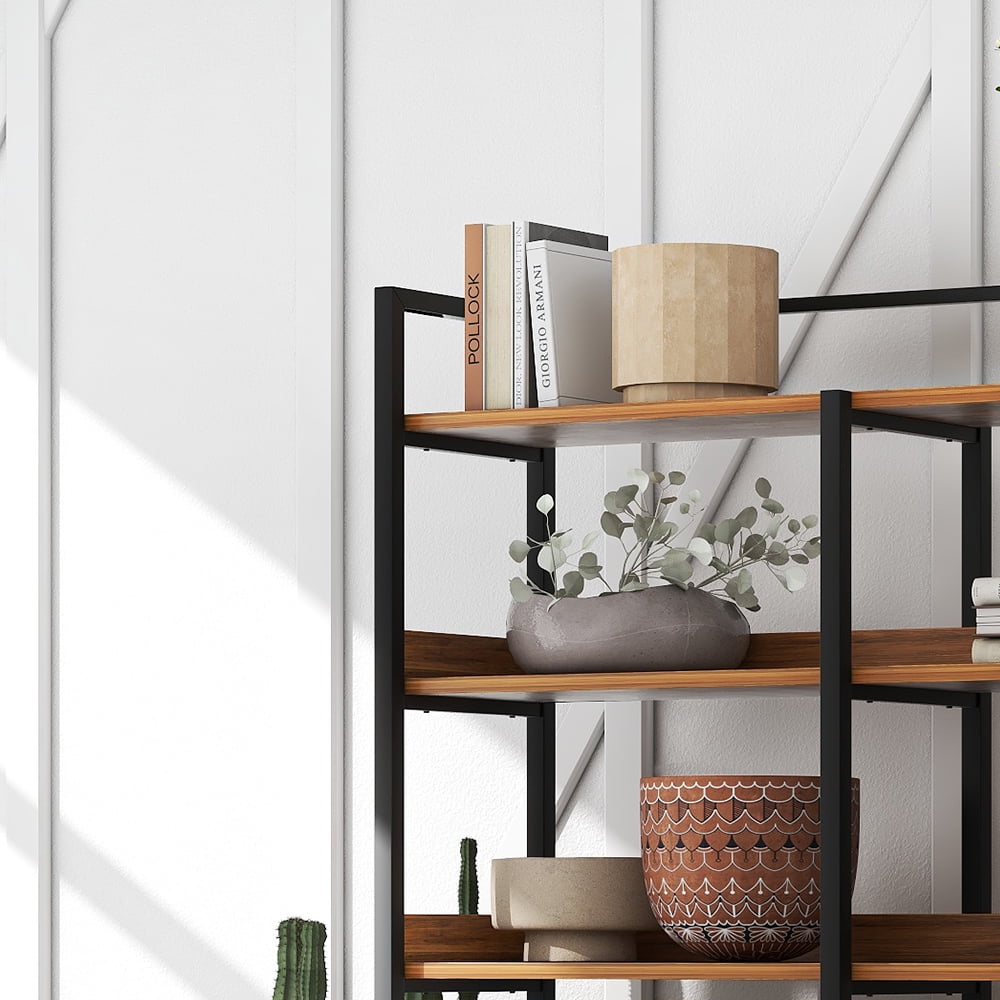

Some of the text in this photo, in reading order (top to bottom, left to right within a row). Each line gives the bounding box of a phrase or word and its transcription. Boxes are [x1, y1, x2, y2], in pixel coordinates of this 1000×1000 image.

[468, 273, 480, 365] POLLOCK
[533, 264, 551, 388] GIORGIO ARMANI
